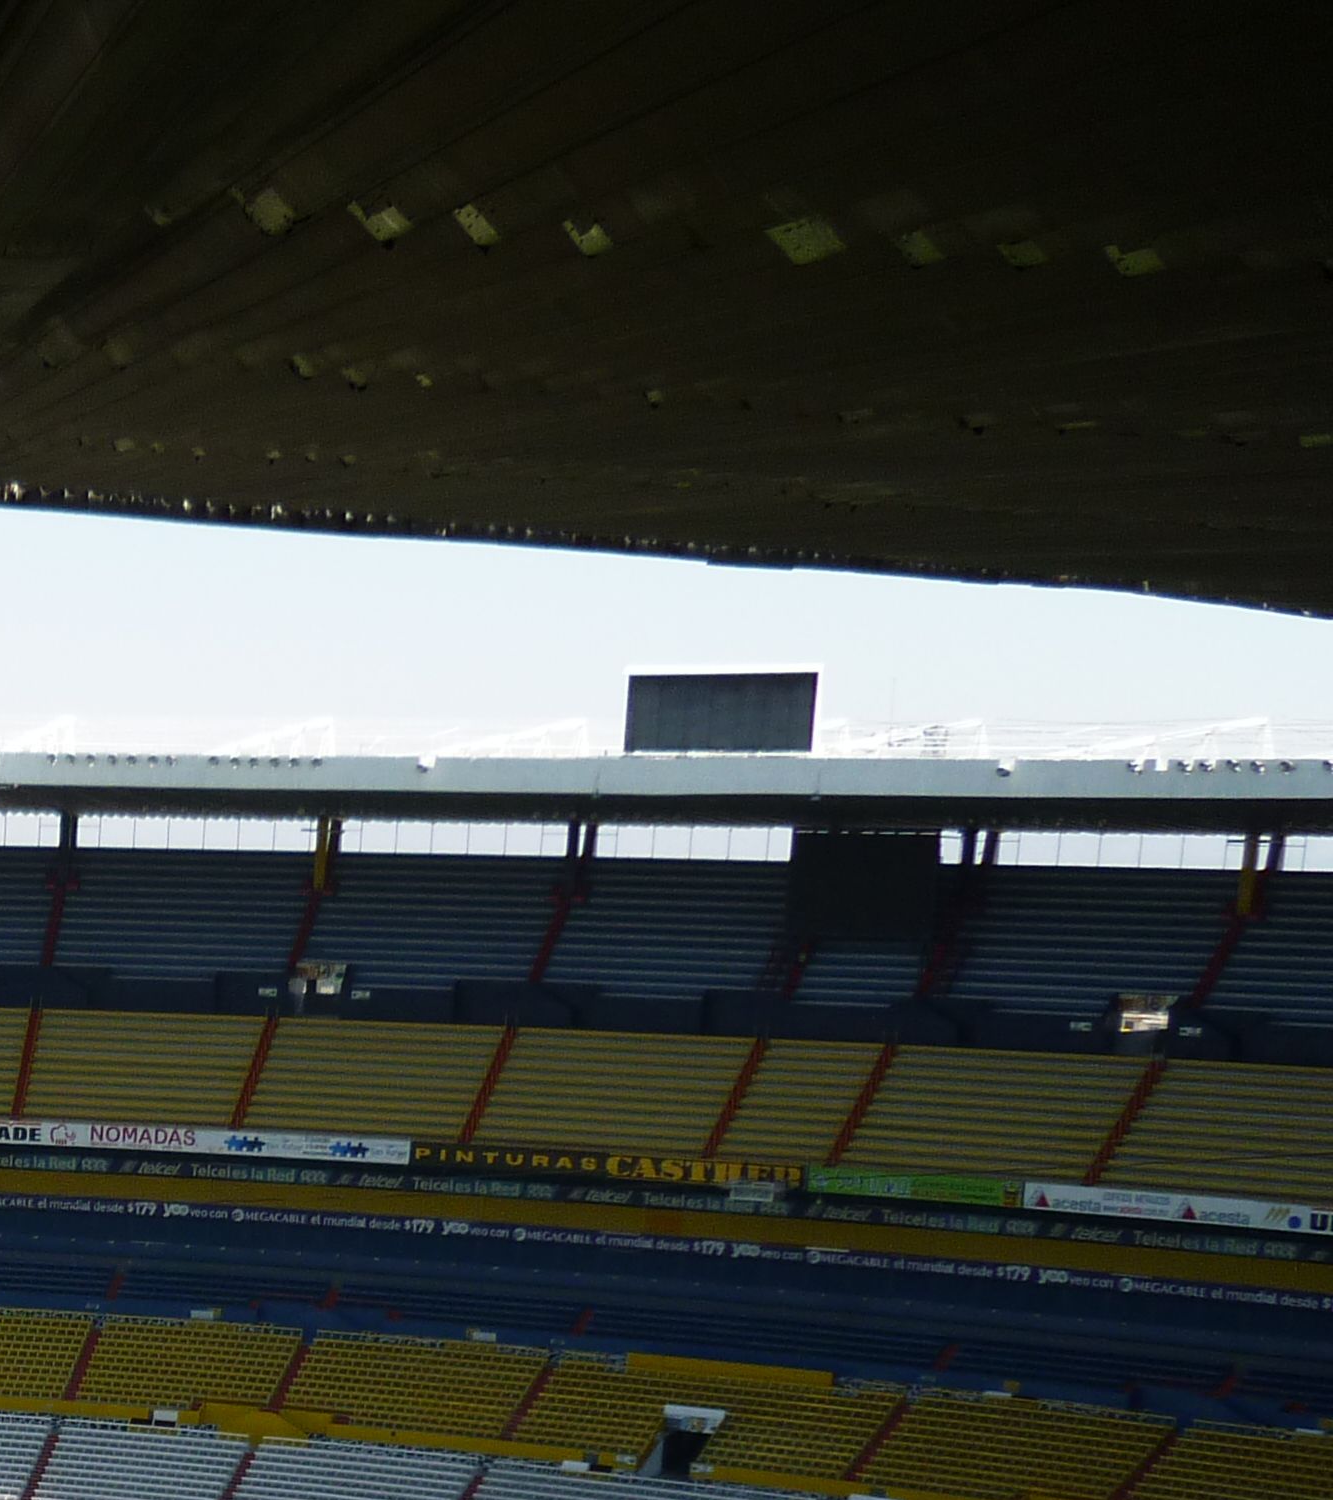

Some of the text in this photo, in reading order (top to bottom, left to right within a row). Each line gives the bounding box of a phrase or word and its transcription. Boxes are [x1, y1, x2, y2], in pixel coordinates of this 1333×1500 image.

[90, 1125, 195, 1146] NOMADAS
[49, 1155, 76, 1170] Red
[415, 1147, 596, 1171] PINTURAS
